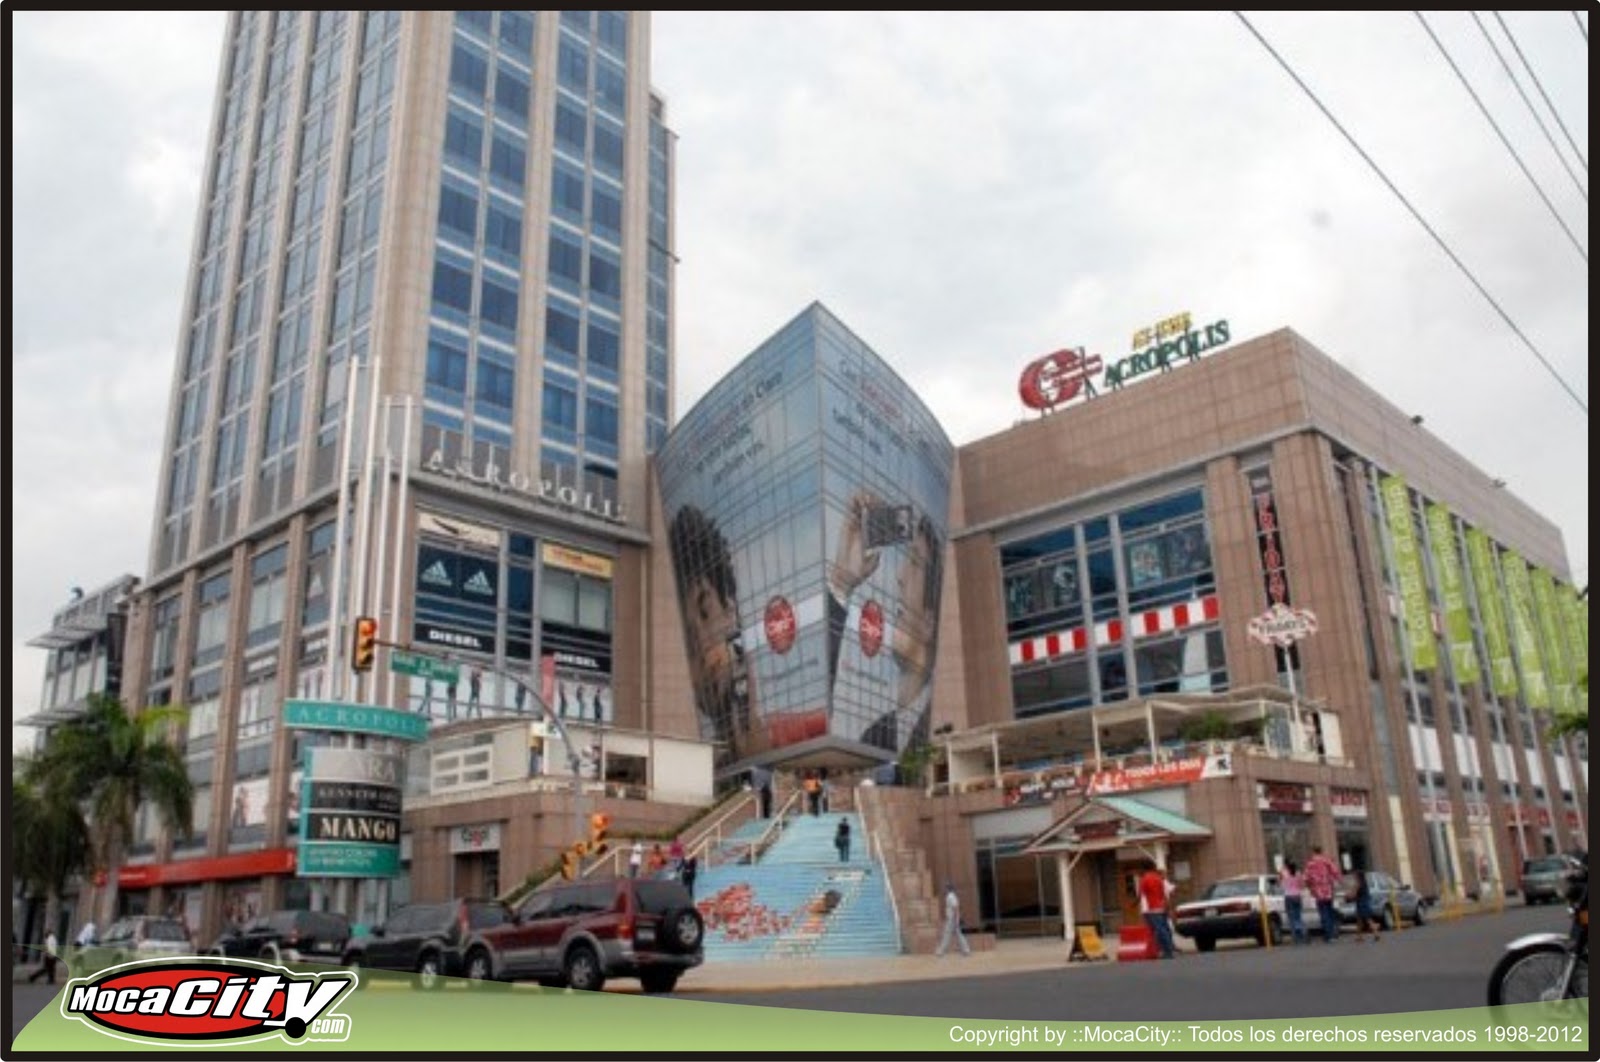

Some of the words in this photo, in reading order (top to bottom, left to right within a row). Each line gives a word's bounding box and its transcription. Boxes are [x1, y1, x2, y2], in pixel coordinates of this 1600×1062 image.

[1104, 319, 1231, 388] ACROPOLIS
[428, 629, 482, 648] DIESEL
[553, 652, 600, 668] DIESEL
[300, 708, 420, 732] ACROPOLI
[320, 816, 397, 840] MANGO
